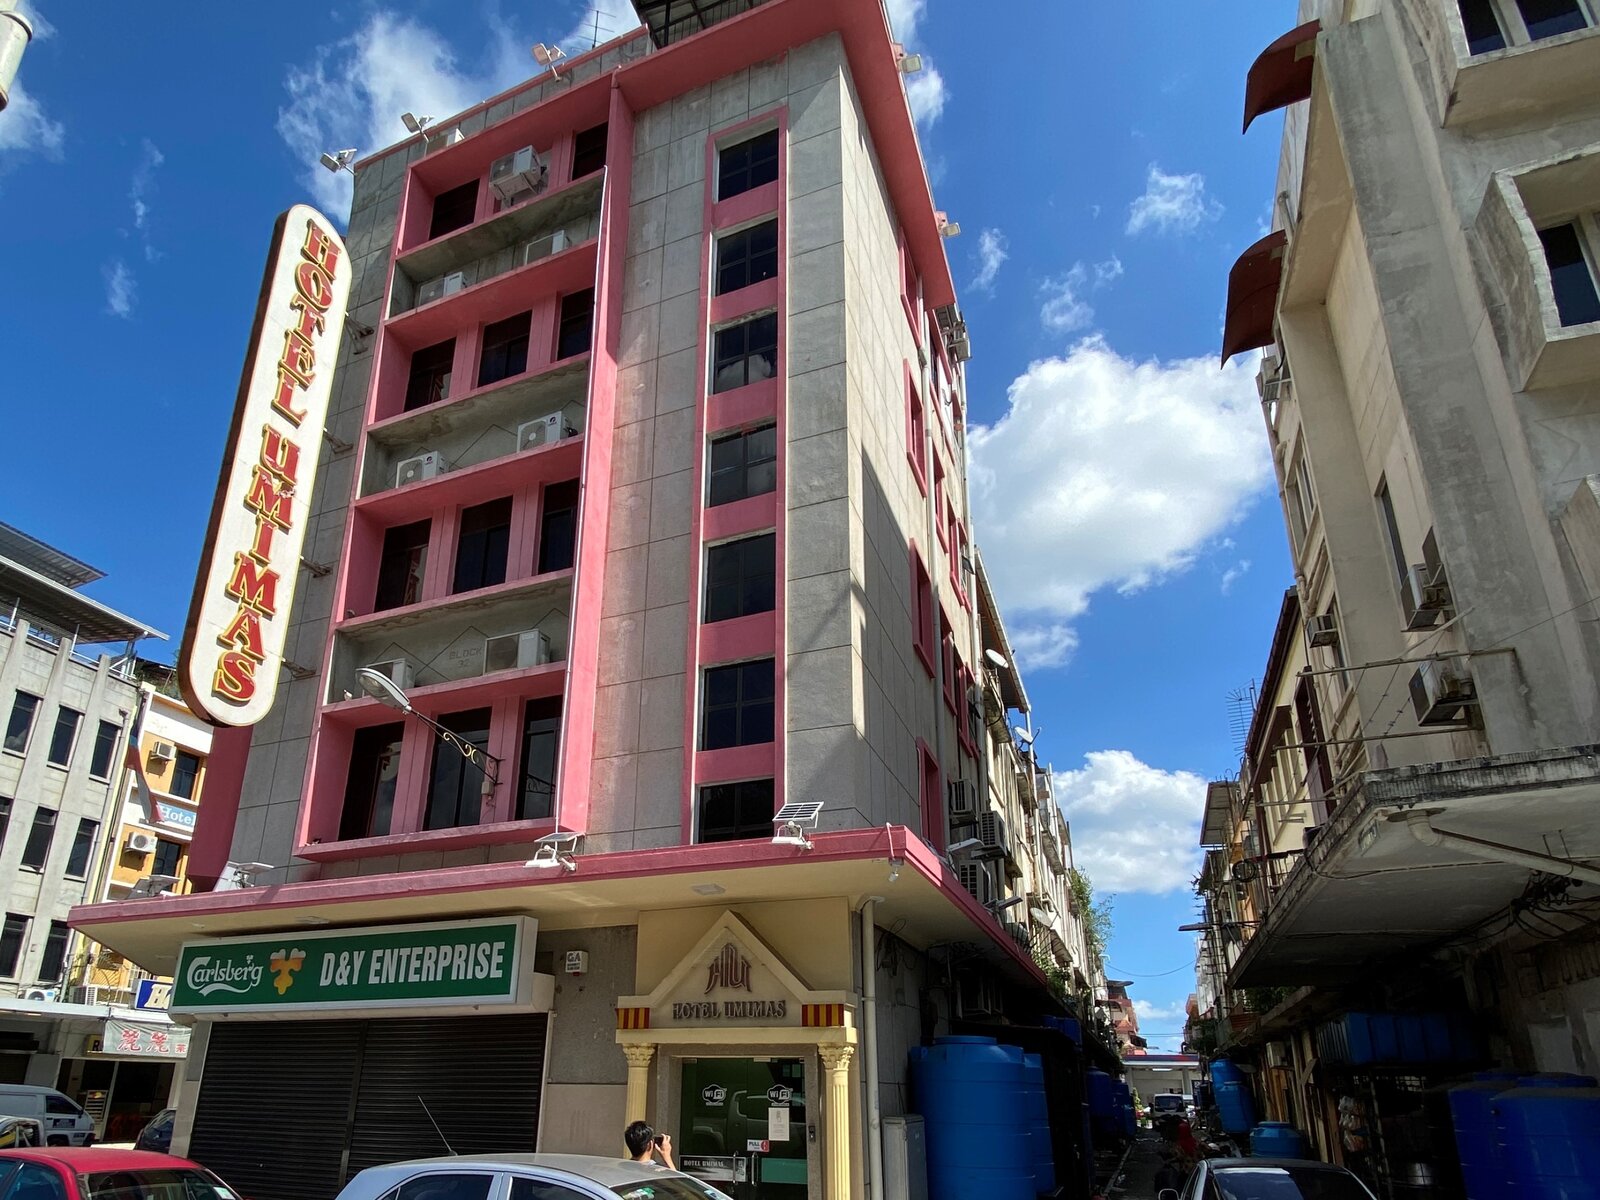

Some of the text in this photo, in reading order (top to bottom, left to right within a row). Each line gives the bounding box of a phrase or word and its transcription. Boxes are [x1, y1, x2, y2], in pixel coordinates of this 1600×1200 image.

[214, 219, 342, 703] HOTEL UMIMAS
[187, 955, 264, 997] Carlsberg
[319, 941, 506, 987] D&Y ENTERPRISE
[673, 1002, 722, 1019] HOTEL
